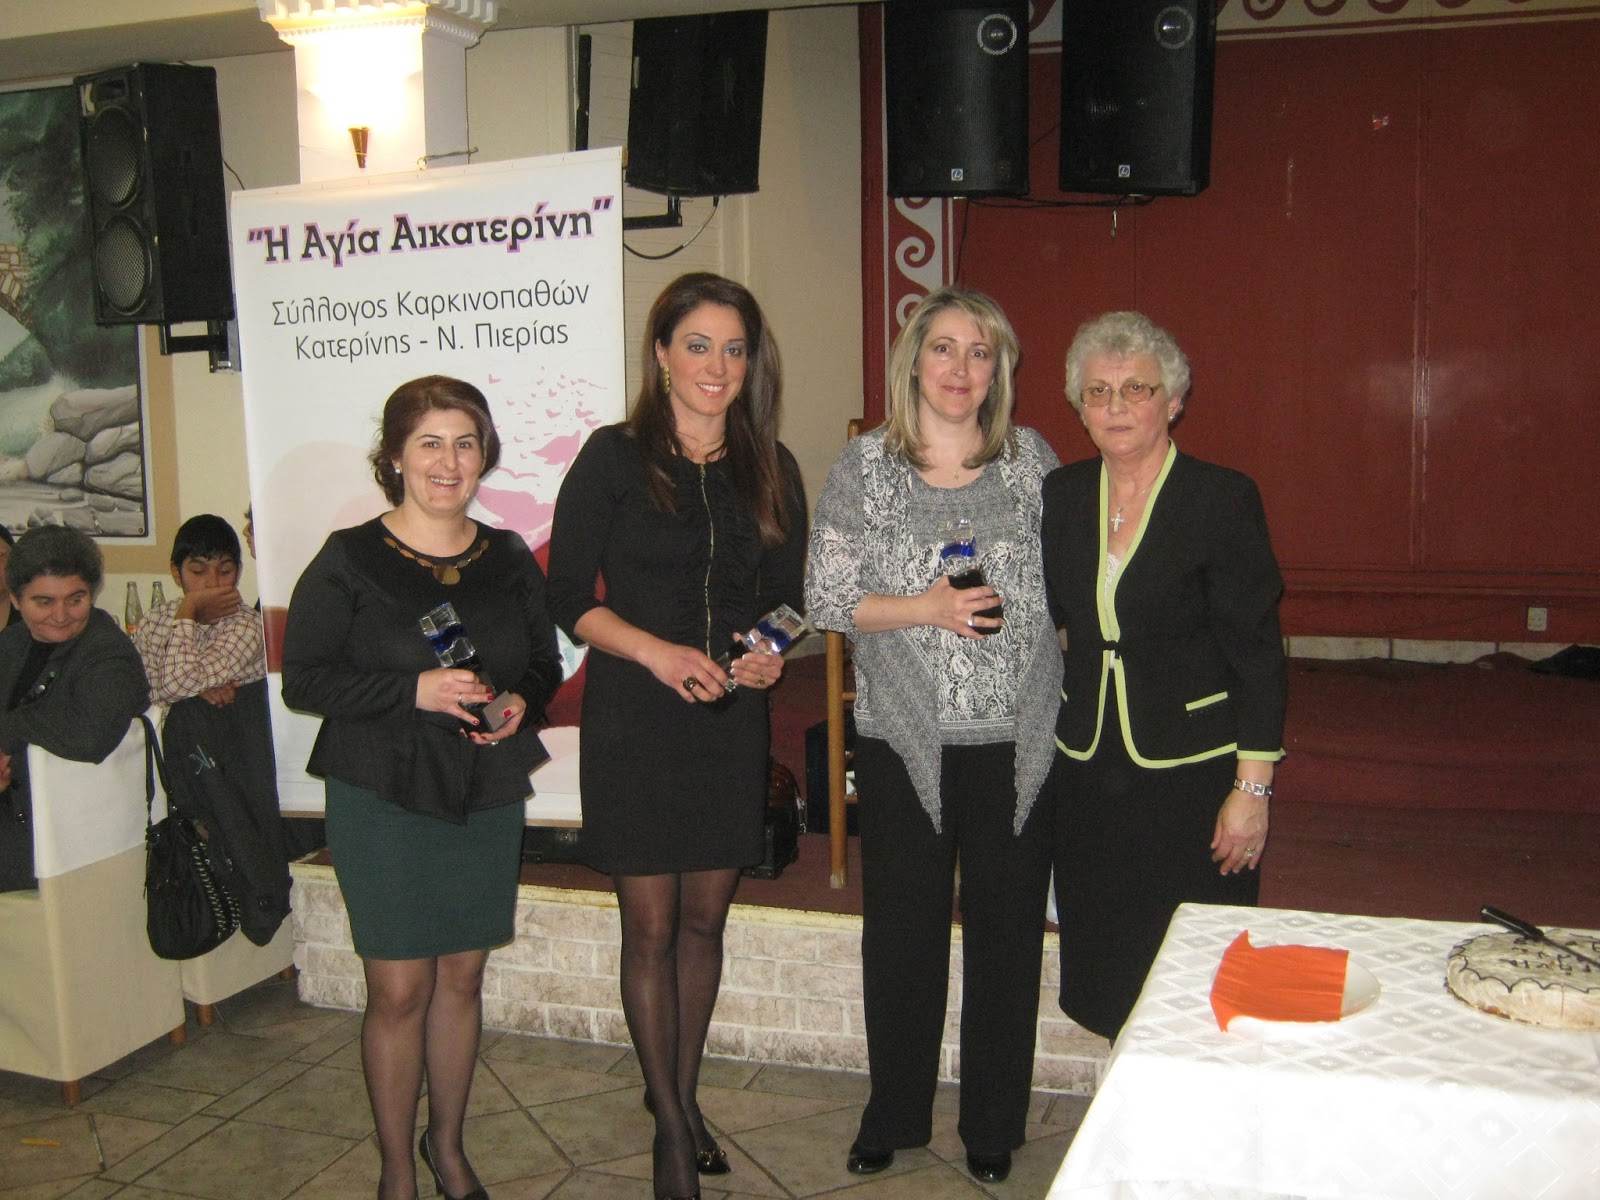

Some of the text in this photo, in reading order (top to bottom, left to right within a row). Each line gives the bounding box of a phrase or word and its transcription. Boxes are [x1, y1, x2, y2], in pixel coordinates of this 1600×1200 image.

[300, 219, 381, 267] Αγία
[272, 279, 590, 326] Σύλλογος Καρκινοπαθών
[295, 331, 411, 361] Κατερίνης
[437, 325, 465, 351] Ν.
[475, 320, 569, 353] Πιερίας
